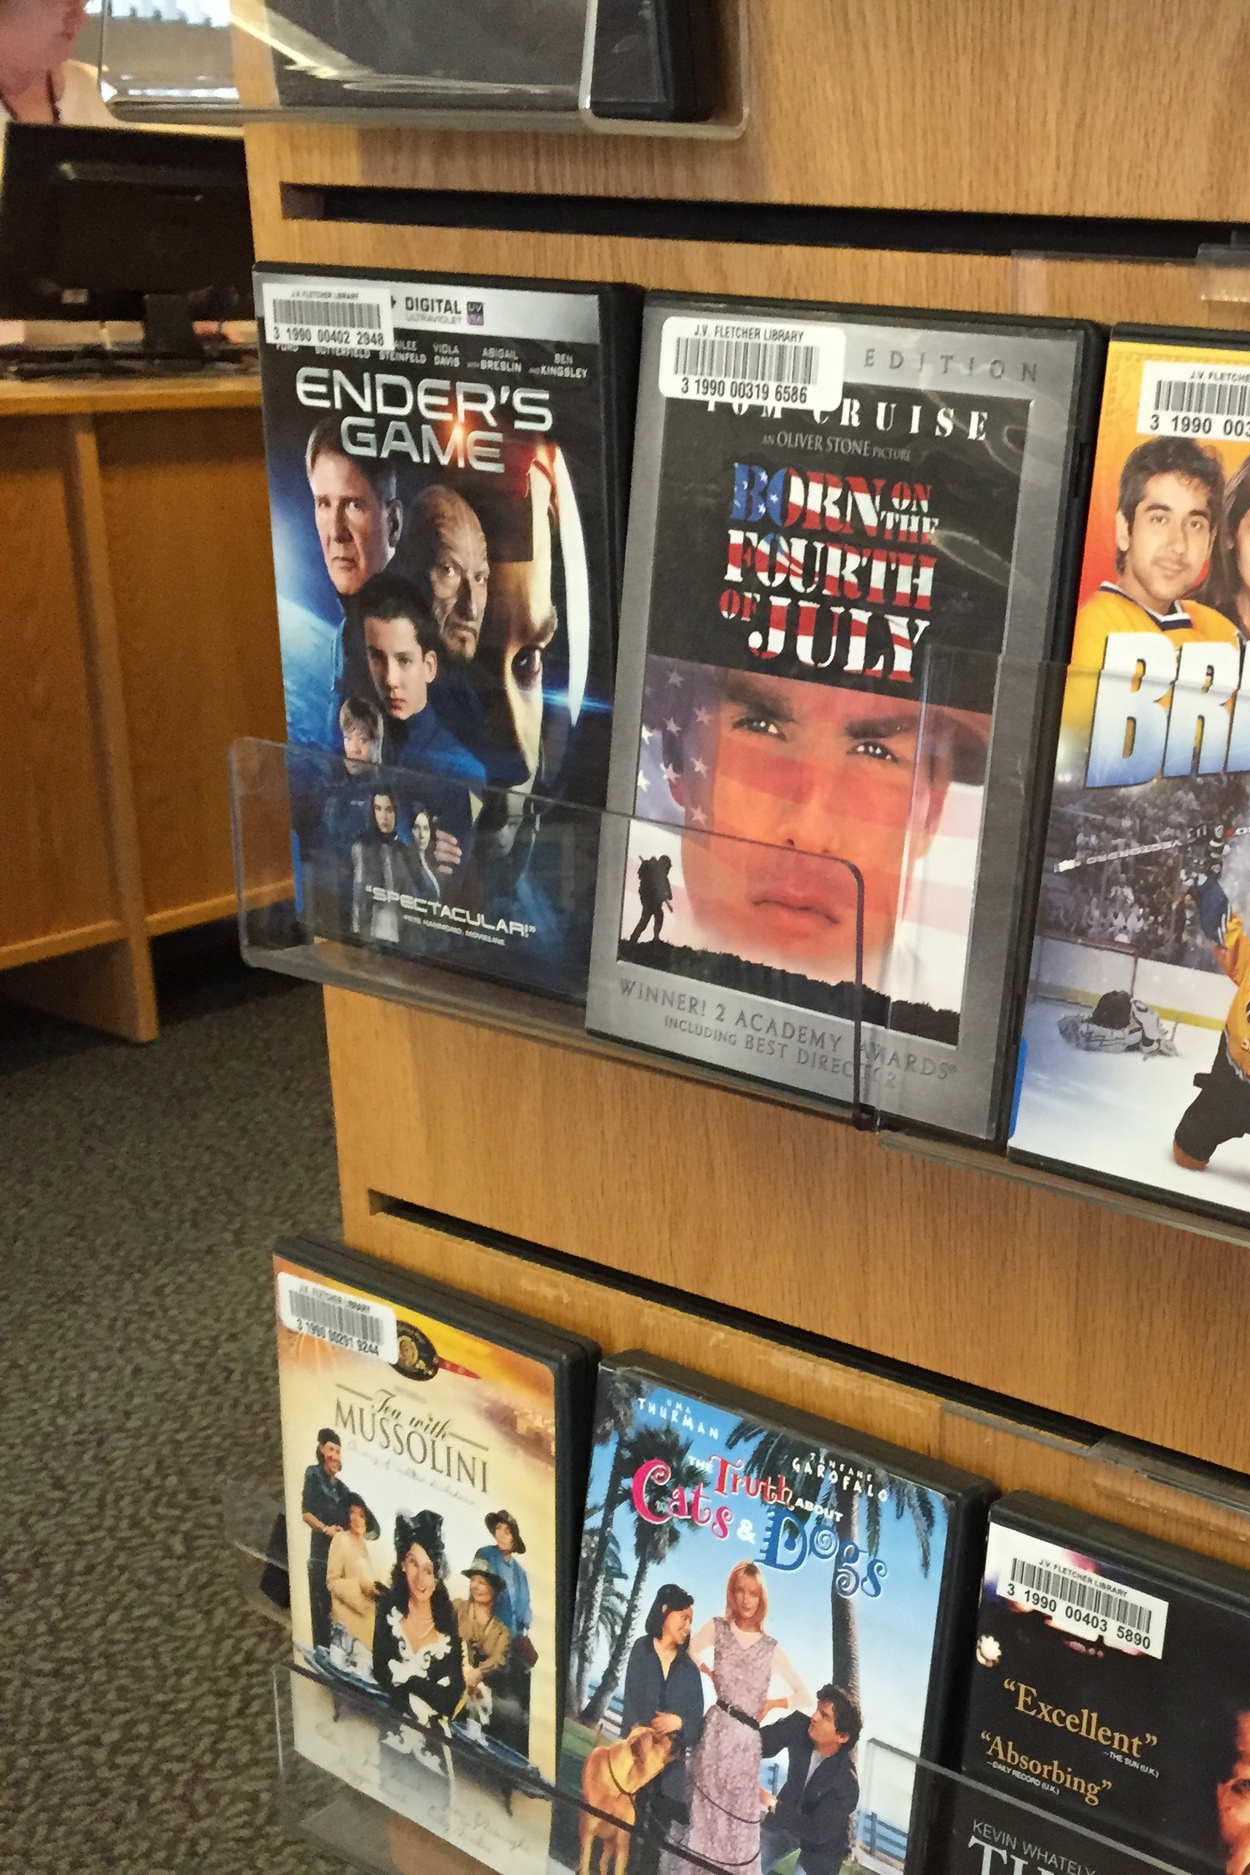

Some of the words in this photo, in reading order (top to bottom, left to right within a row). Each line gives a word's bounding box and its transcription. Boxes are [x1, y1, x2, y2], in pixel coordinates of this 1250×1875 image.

[405, 296, 461, 314] DIGITAL
[273, 326, 281, 340] 3
[286, 327, 312, 342] 1990
[317, 329, 350, 345] 00402
[433, 343, 460, 354] VIOLA
[714, 325, 760, 341] FLETCHER
[764, 328, 804, 343] LIBRARY
[434, 355, 461, 367] DAVIS
[480, 359, 522, 373] BRESLIN
[540, 365, 589, 379] KINGSLEY
[554, 353, 574, 364] BEN
[864, 348, 1039, 382] EDITION
[296, 366, 553, 432] ENDER'S
[681, 377, 689, 394] 3
[694, 379, 725, 397] 1990
[730, 381, 770, 401] 00319
[775, 384, 808, 404] 6586
[1149, 414, 1160, 431] 3
[1171, 415, 1213, 434] 1990
[341, 416, 505, 473] GAME
[776, 431, 823, 451] OLIVER
[826, 436, 871, 457] STONE
[872, 446, 912, 462] PICTURE
[729, 462, 887, 538] BORN
[892, 481, 932, 513] ON
[880, 510, 940, 545] THE
[723, 529, 938, 611] FOURTH
[719, 589, 761, 622] OF
[747, 594, 931, 683] JULY
[620, 978, 707, 1017] WINNER!
[715, 1004, 726, 1023] 2
[735, 1010, 842, 1052] ACADEMY
[664, 1015, 737, 1047] INCLUDING
[744, 1035, 788, 1059] BEST
[637, 1397, 719, 1440] THURMAN
[666, 1399, 692, 1414] UMA
[408, 1412, 451, 1441] with
[334, 1398, 489, 1493] MUSSOLINI
[688, 1455, 714, 1474] THE
[708, 1454, 795, 1512] Truth
[794, 1496, 844, 1522] ABOUT
[791, 1457, 888, 1502] GAROFALO
[631, 1458, 734, 1540] Cats
[737, 1518, 756, 1545] &
[753, 1508, 888, 1600] Dogs
[1053, 1564, 1093, 1585] FLETCHER
[1094, 1580, 1128, 1598] LIBRARY
[1007, 1583, 1016, 1597] 3
[1024, 1590, 1057, 1613] 1990
[1065, 1605, 1108, 1632] 00403
[1116, 1626, 1151, 1650] 5890
[1012, 1768, 1041, 1786] RECORD
[1124, 1757, 1140, 1770] SUN
[972, 1819, 1017, 1850] KEVIN
